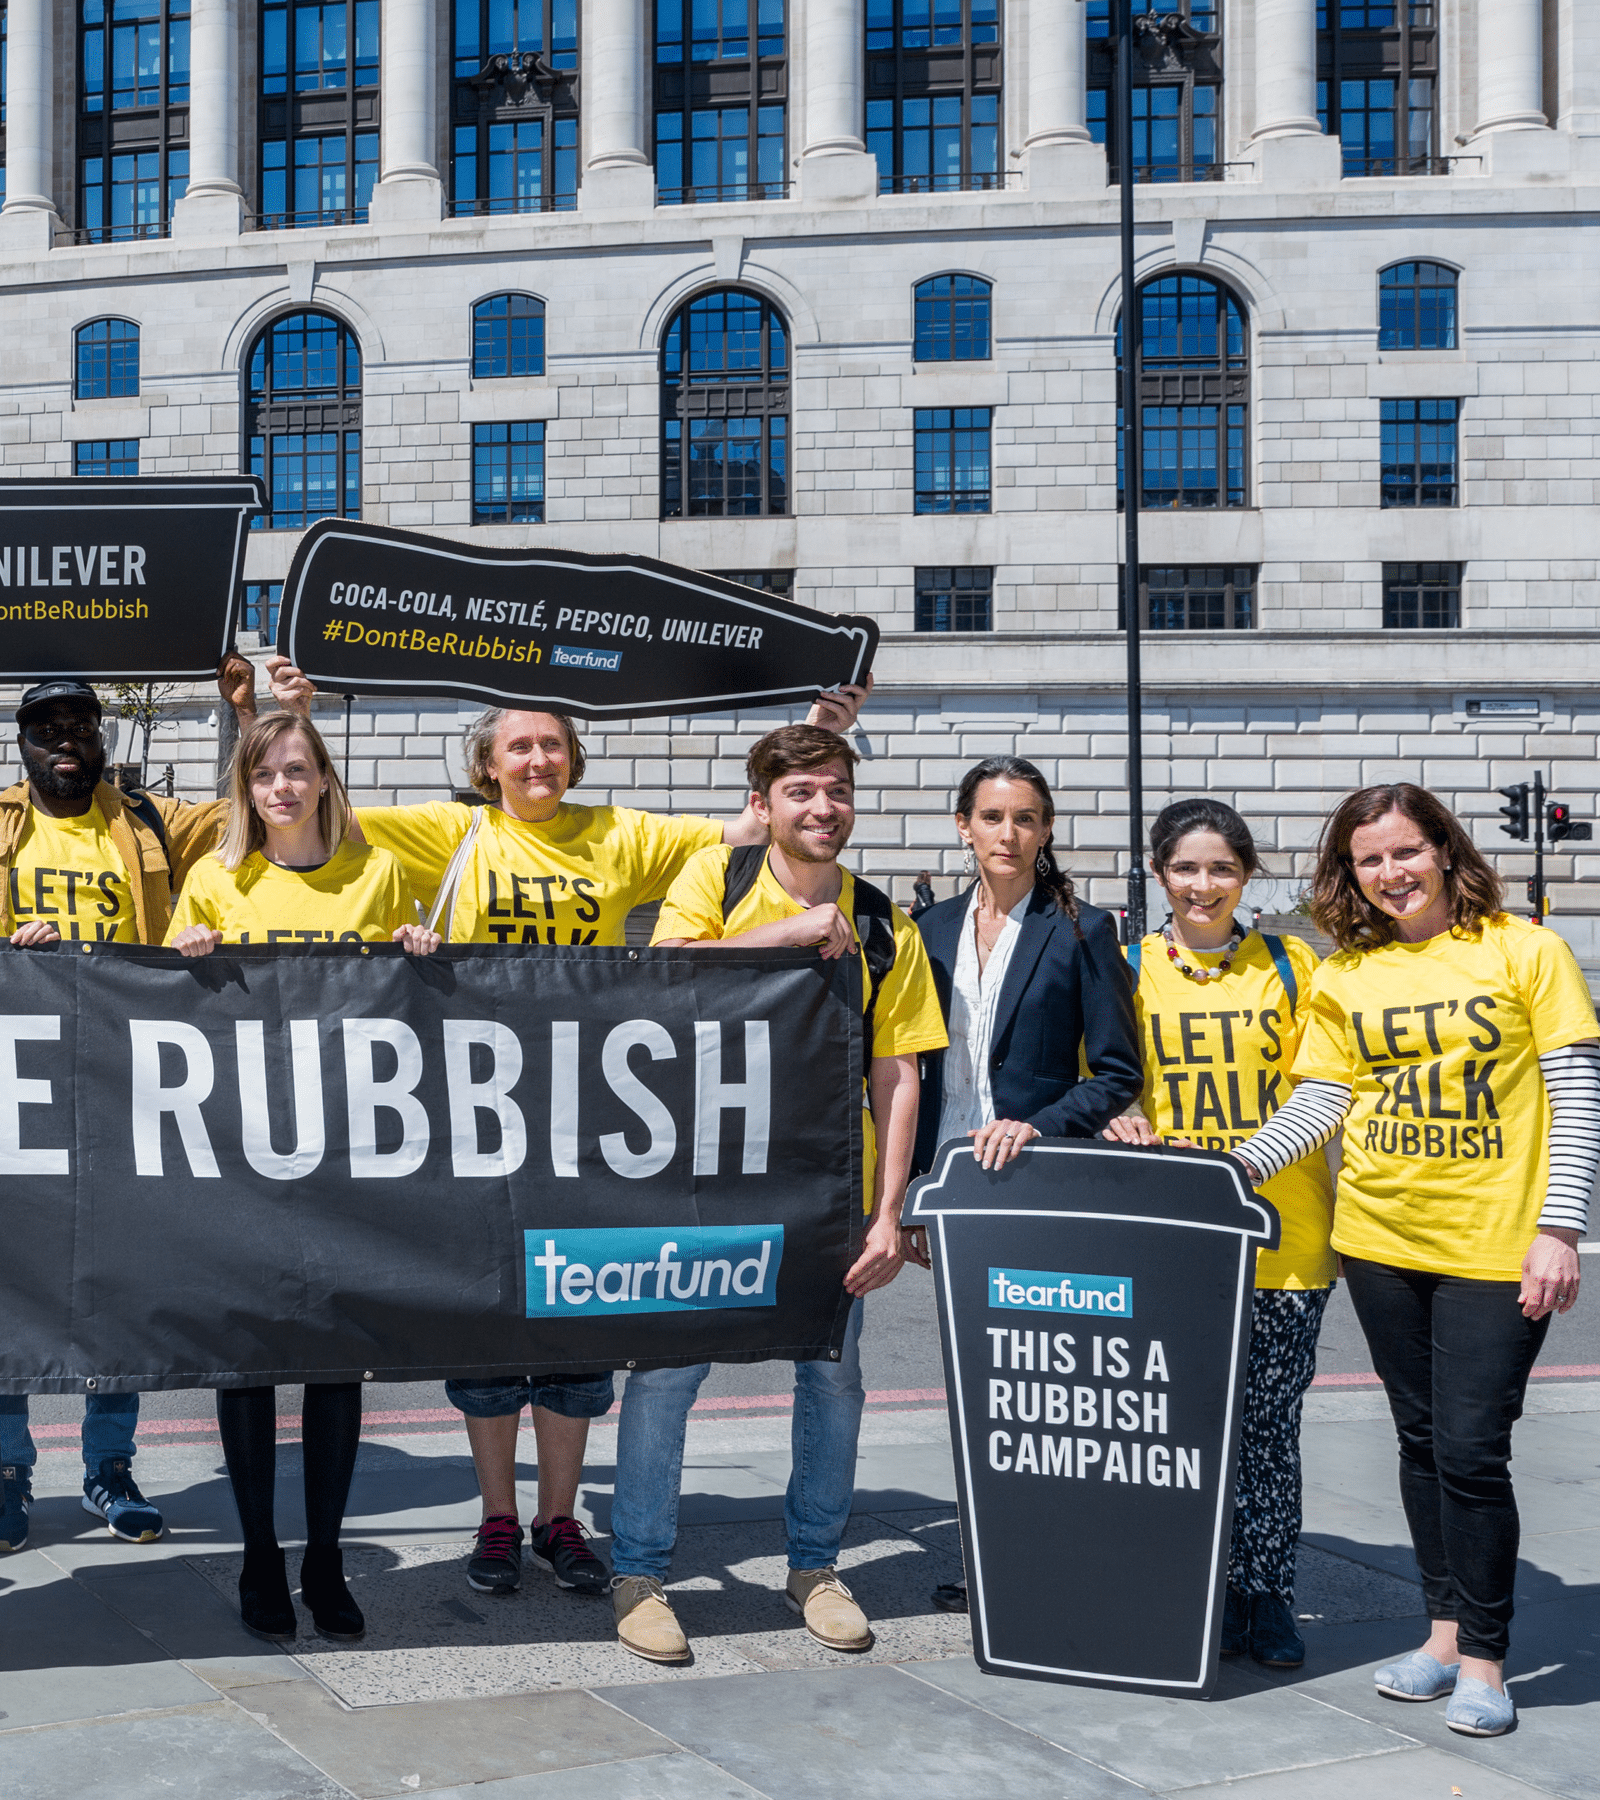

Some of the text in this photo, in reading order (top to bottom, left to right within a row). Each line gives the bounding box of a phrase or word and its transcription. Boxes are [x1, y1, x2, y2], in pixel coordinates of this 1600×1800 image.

[322, 619, 542, 664] #DontBeRubbish
[329, 581, 763, 650] COCA-COLA, NESTLÉ, PEPSICO, UNILEVER
[551, 646, 621, 671] tearfund
[10, 867, 121, 917] LET'S
[488, 869, 601, 923] LET'S
[1150, 1009, 1283, 1066] LET'S
[1352, 995, 1502, 1064] LET'S
[128, 1016, 771, 1181] RUBBISH
[1163, 1069, 1283, 1130] TALK
[1371, 1058, 1501, 1120] TALK
[1364, 1119, 1504, 1159] RUBBISH
[534, 1239, 771, 1305] tearfund
[992, 1272, 1126, 1312] tearfund
[986, 1326, 1170, 1383] THIS IS A
[988, 1378, 1168, 1435] RUBBISH
[988, 1429, 1201, 1490] CAMPAIGN
